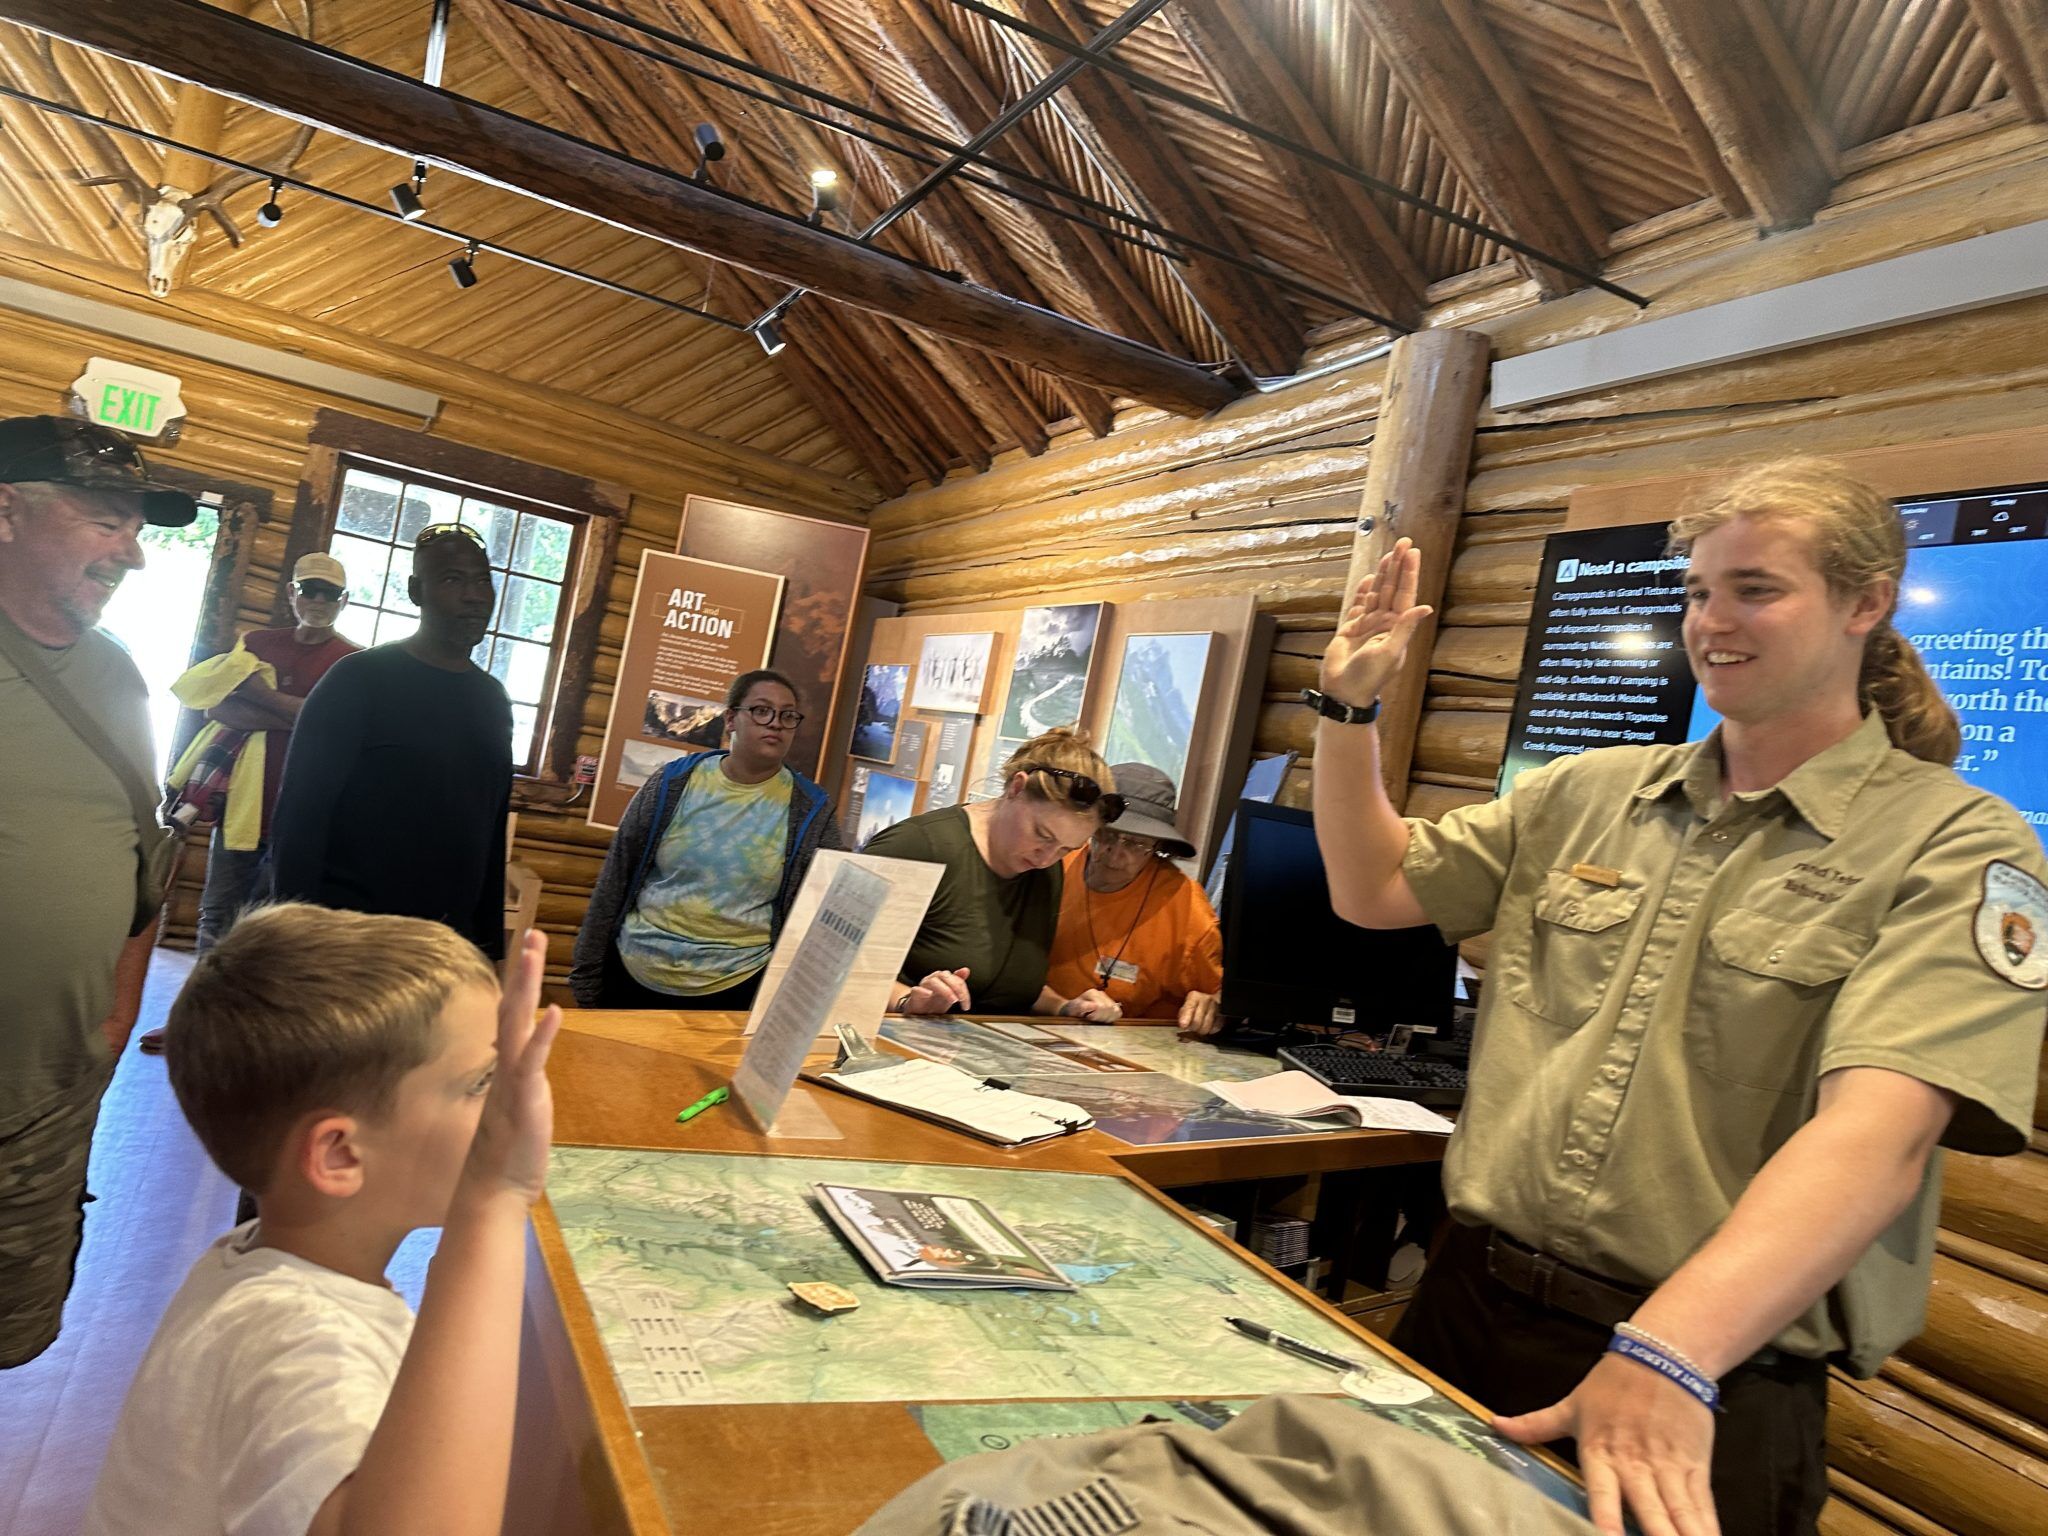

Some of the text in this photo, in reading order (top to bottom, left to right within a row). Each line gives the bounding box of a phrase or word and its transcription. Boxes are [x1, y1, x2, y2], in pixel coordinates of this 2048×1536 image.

[100, 384, 161, 431] EXIT
[1578, 561, 1614, 576] Need
[1614, 563, 1625, 574] a
[667, 588, 707, 611] ART
[1552, 586, 1687, 601] Campgrounds in Grand Teton are
[702, 608, 720, 616] and
[1549, 608, 1570, 617] often
[1570, 607, 1588, 617] fully
[1622, 604, 1682, 615] Campgrounds
[663, 609, 734, 639] ACTION
[1545, 623, 1652, 635] and dispersed campsites in
[1542, 642, 1589, 651] surrounding
[1656, 641, 1673, 649] are
[1909, 628, 2018, 656] greeting
[1539, 658, 1560, 667] often
[1583, 658, 1594, 668] by
[1594, 658, 1611, 667] late
[1611, 658, 1648, 668] morning
[1648, 659, 1660, 667] or
[1570, 675, 1607, 684] Overflow
[1607, 676, 1621, 684] RV
[1621, 677, 1659, 687] camping
[1659, 676, 1669, 686] is
[1532, 692, 1658, 704] available at Blackrock Meadows
[1529, 709, 1669, 724] east of the park towards Togwotee
[1526, 724, 1656, 741] Pass or Moran Vista near Spread
[1998, 725, 2016, 743] a
[1522, 741, 1585, 754] Creek dispersed
